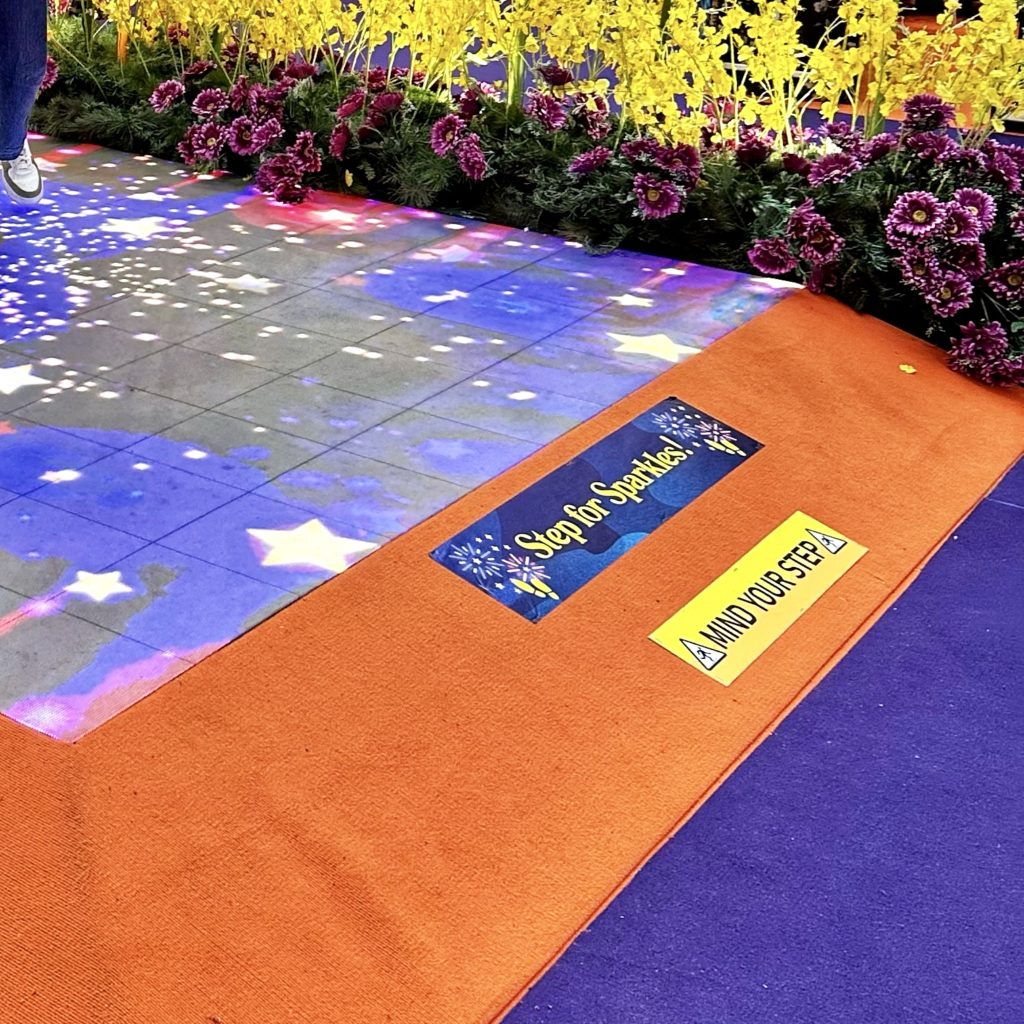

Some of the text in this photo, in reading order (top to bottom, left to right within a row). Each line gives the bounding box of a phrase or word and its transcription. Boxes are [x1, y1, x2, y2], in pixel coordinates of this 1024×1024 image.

[514, 435, 694, 559] Step for Sparkles!
[698, 540, 825, 650] MIND YOUR STEP
